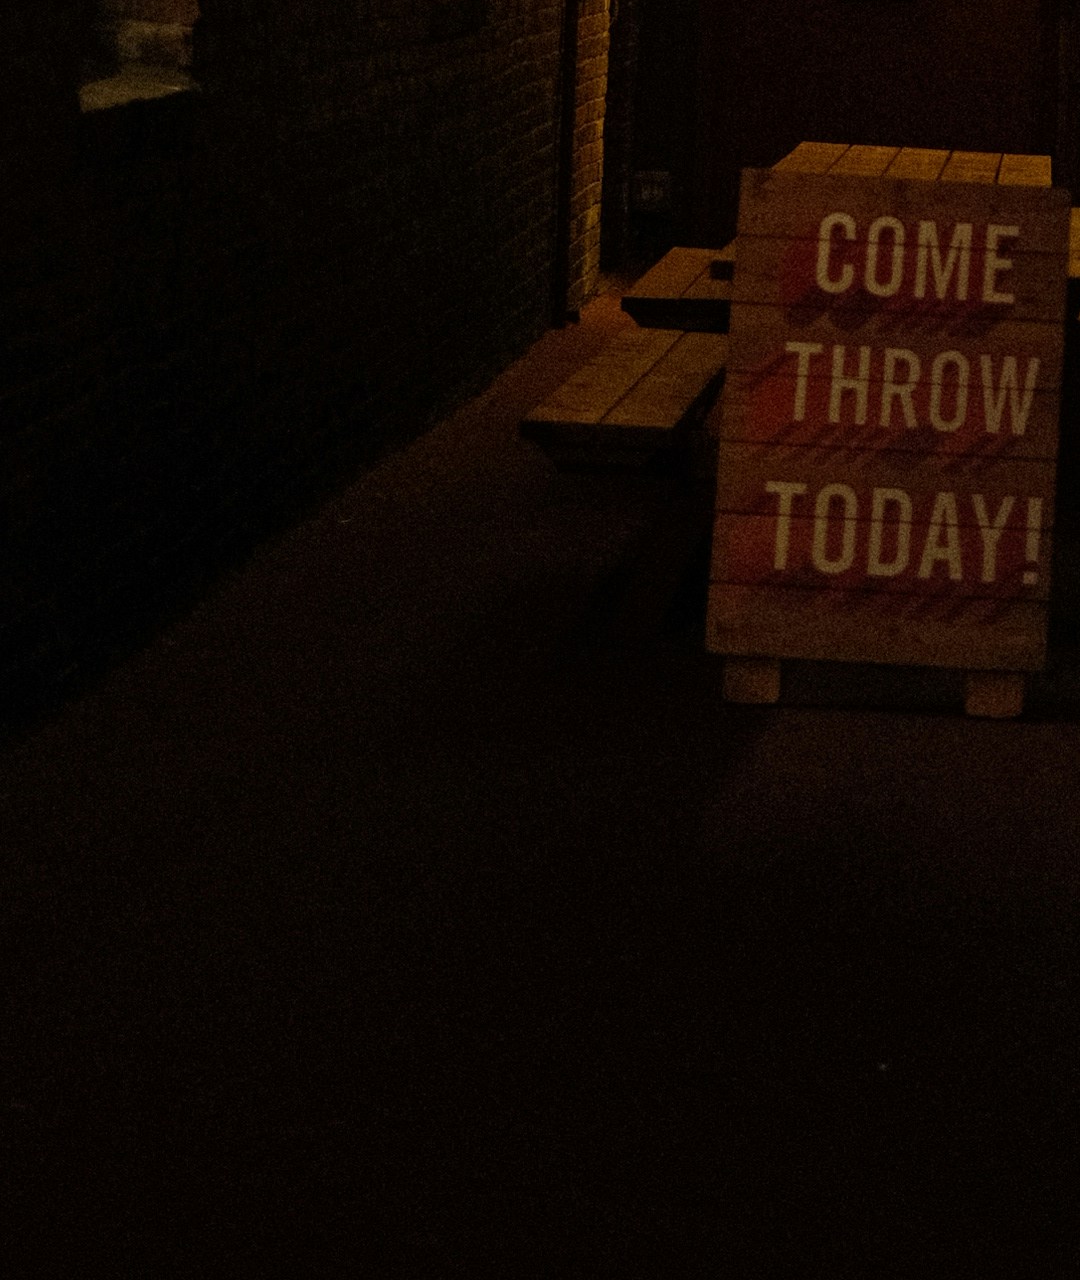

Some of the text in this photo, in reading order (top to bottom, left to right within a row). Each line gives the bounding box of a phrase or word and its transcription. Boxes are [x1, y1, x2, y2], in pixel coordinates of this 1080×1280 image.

[815, 212, 1020, 304] COME
[786, 342, 1040, 436] THROW
[765, 481, 1043, 585] TODAY!
